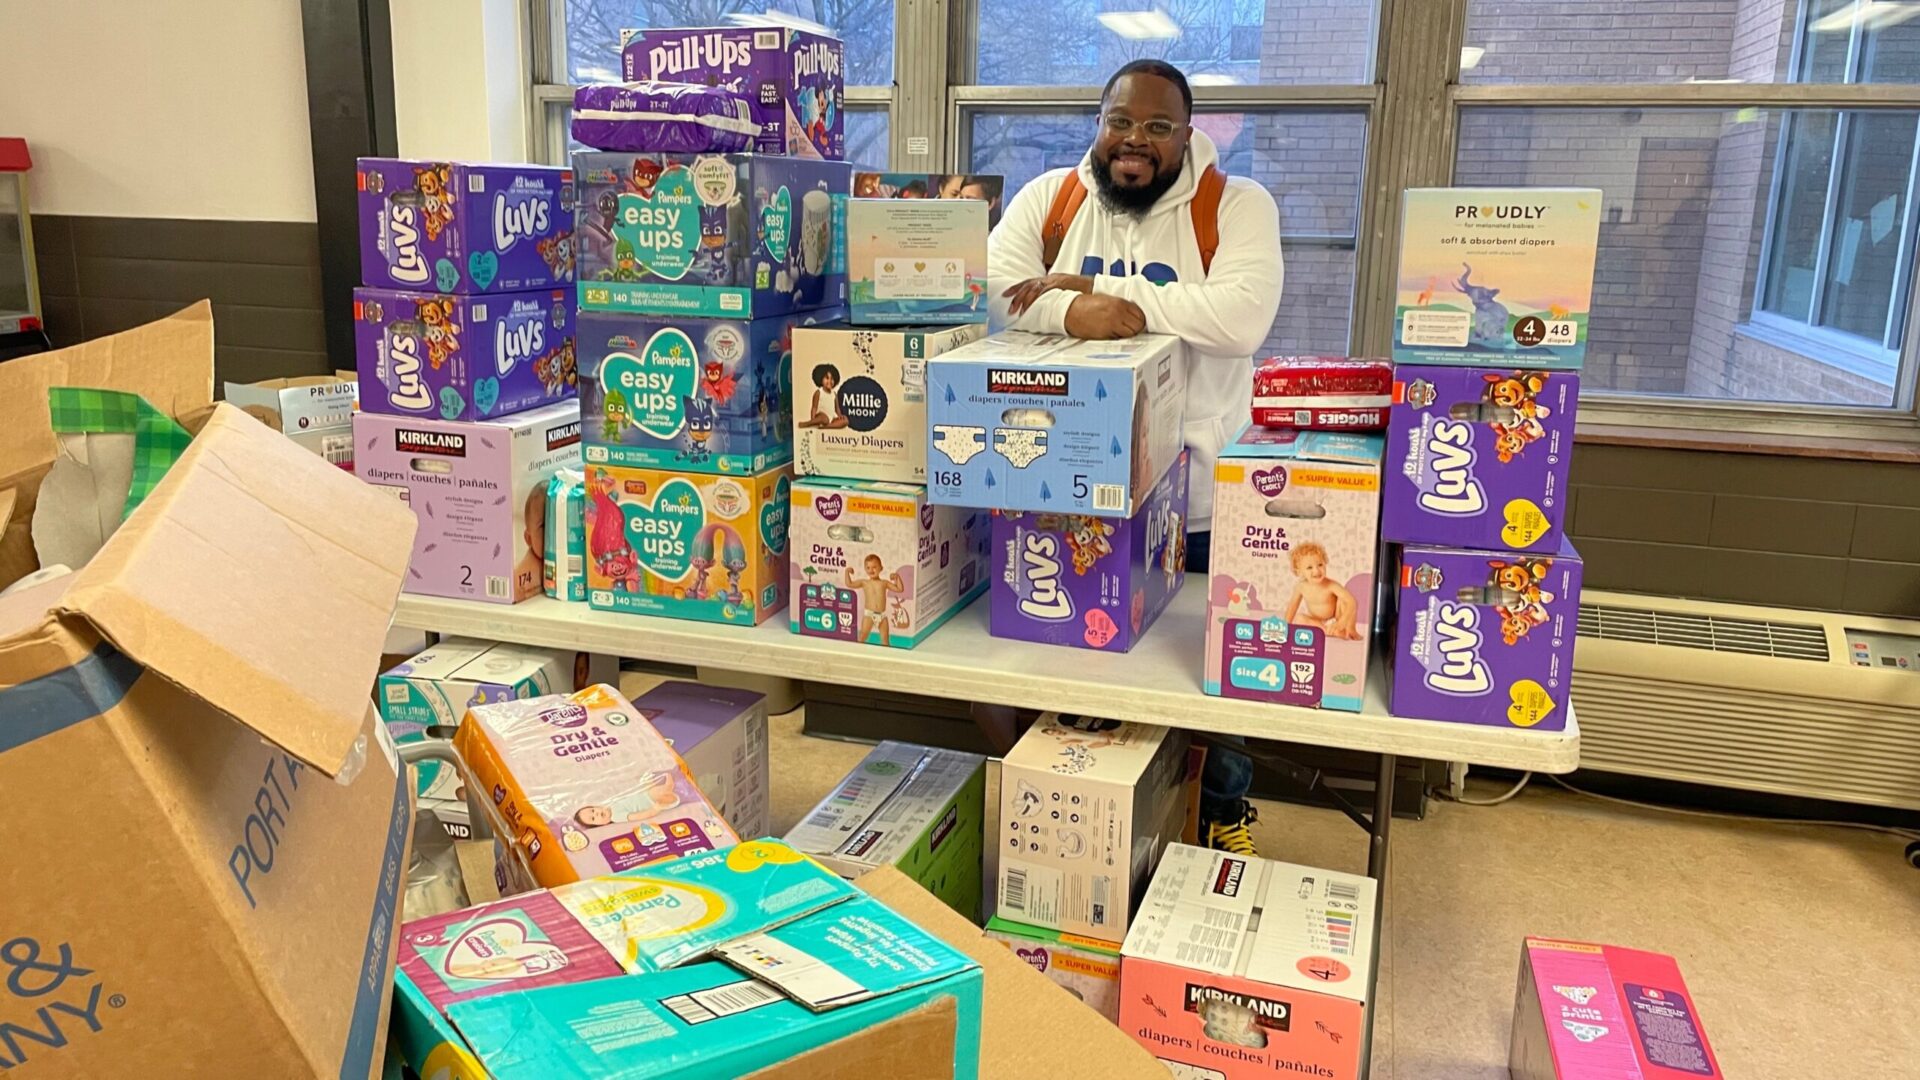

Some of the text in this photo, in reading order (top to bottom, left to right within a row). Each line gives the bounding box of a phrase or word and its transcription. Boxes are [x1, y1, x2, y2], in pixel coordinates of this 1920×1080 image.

[657, 193, 691, 205] Pampers
[495, 195, 549, 250] Luvs
[624, 206, 680, 230] easy
[766, 214, 784, 228] easy
[639, 230, 683, 252] ups
[770, 230, 784, 243] ups
[1441, 237, 1555, 247] soft & absorbent diapers
[390, 206, 429, 283] Luvs
[613, 293, 627, 302] 140
[1523, 320, 1535, 335] 4
[1551, 325, 1569, 336] 48
[497, 320, 543, 375] Luvs
[910, 338, 918, 350] 6
[652, 350, 690, 368] Pampers
[390, 335, 433, 410] Luvs
[992, 371, 1066, 386] KIRKLAND
[621, 370, 674, 392] easy
[635, 392, 677, 412] ups
[843, 393, 881, 408] Millie
[968, 395, 1086, 408] diapers couches pañales
[848, 408, 876, 417] MOON
[1318, 414, 1379, 424] HUGGIES
[399, 431, 463, 448] KIRKLAND
[548, 423, 581, 442] KIRKLAN
[821, 433, 904, 449] Luxury Diapers
[528, 449, 579, 471] diapers couches
[611, 452, 624, 460] 140
[1422, 422, 1482, 512] Luvs
[368, 468, 498, 490] diapers couches pañales
[934, 471, 962, 486] 168
[1256, 473, 1284, 485] Parent's
[1306, 475, 1365, 486] SUPER VALUE
[1073, 474, 1088, 499] 5
[1262, 483, 1281, 492] CHOICE
[661, 499, 699, 516] Pampers
[819, 500, 841, 510] Parent's
[857, 502, 904, 513] SUPER VALUE
[766, 507, 784, 525] easy
[630, 518, 683, 539] easy
[771, 525, 785, 539] ups
[1246, 525, 1286, 539] Dry &
[644, 538, 685, 556] ups
[919, 536, 928, 548] Dry
[1242, 538, 1290, 550] Gentle
[812, 544, 844, 556] Dry &
[1252, 551, 1278, 559] Diapers
[810, 554, 847, 568] Gentle
[460, 565, 473, 586] 2
[818, 566, 839, 574] Diapers
[1021, 535, 1071, 618] Luvs
[518, 571, 532, 586] 174
[616, 597, 629, 605] 140
[821, 613, 832, 628] 6
[1429, 605, 1489, 691] Luvs
[1236, 663, 1280, 686] Size 4
[1295, 664, 1310, 672] 192
[550, 727, 607, 744] Dry &
[553, 737, 619, 757] Gentle
[575, 751, 610, 762] Diapers
[229, 756, 290, 909] PORT
[691, 854, 724, 869] 186
[1224, 860, 1243, 896] KIRKLAND
[588, 894, 682, 927] Pampers
[1065, 960, 1091, 970] SUPER
[1309, 968, 1337, 981] 4
[1561, 1011, 1603, 1021] prints
[1571, 1007, 1601, 1015] cute
[1139, 1027, 1334, 1079] diapers couches pañales
